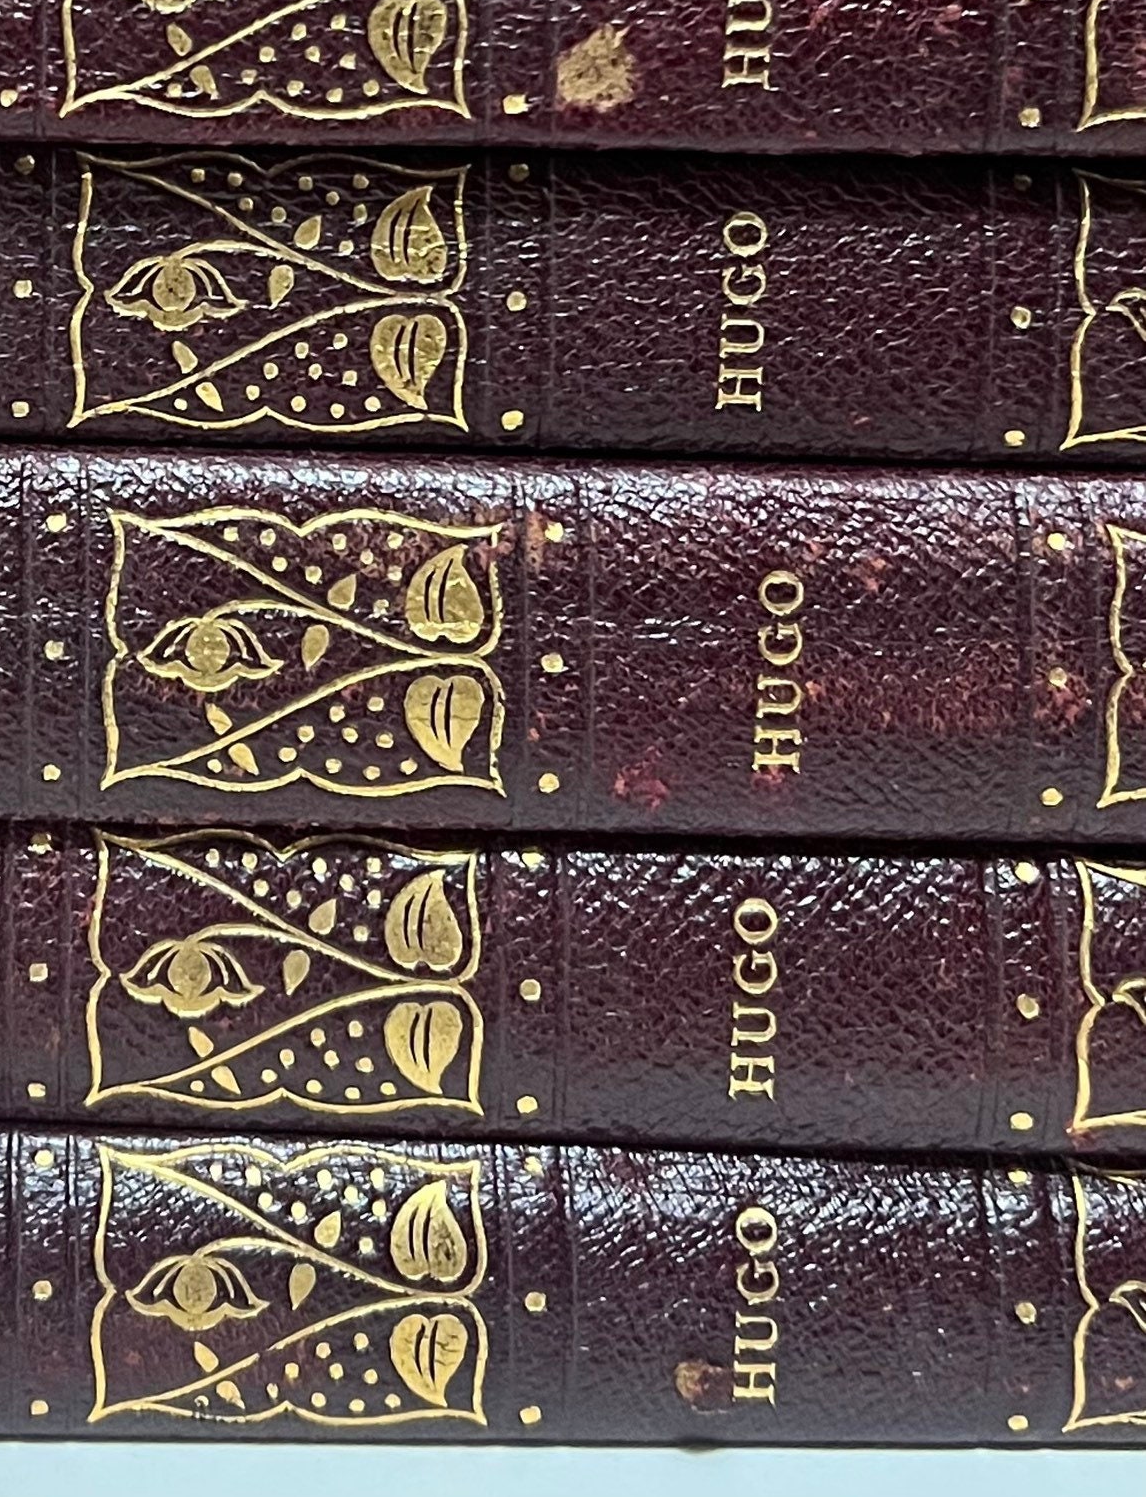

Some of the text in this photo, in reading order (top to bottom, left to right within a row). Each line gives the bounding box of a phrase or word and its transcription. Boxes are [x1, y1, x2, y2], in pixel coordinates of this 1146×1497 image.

[714, 209, 770, 414] HUGO
[752, 567, 806, 776] HUGO
[729, 896, 781, 1102] HUGO
[732, 1205, 780, 1406] HUGO
